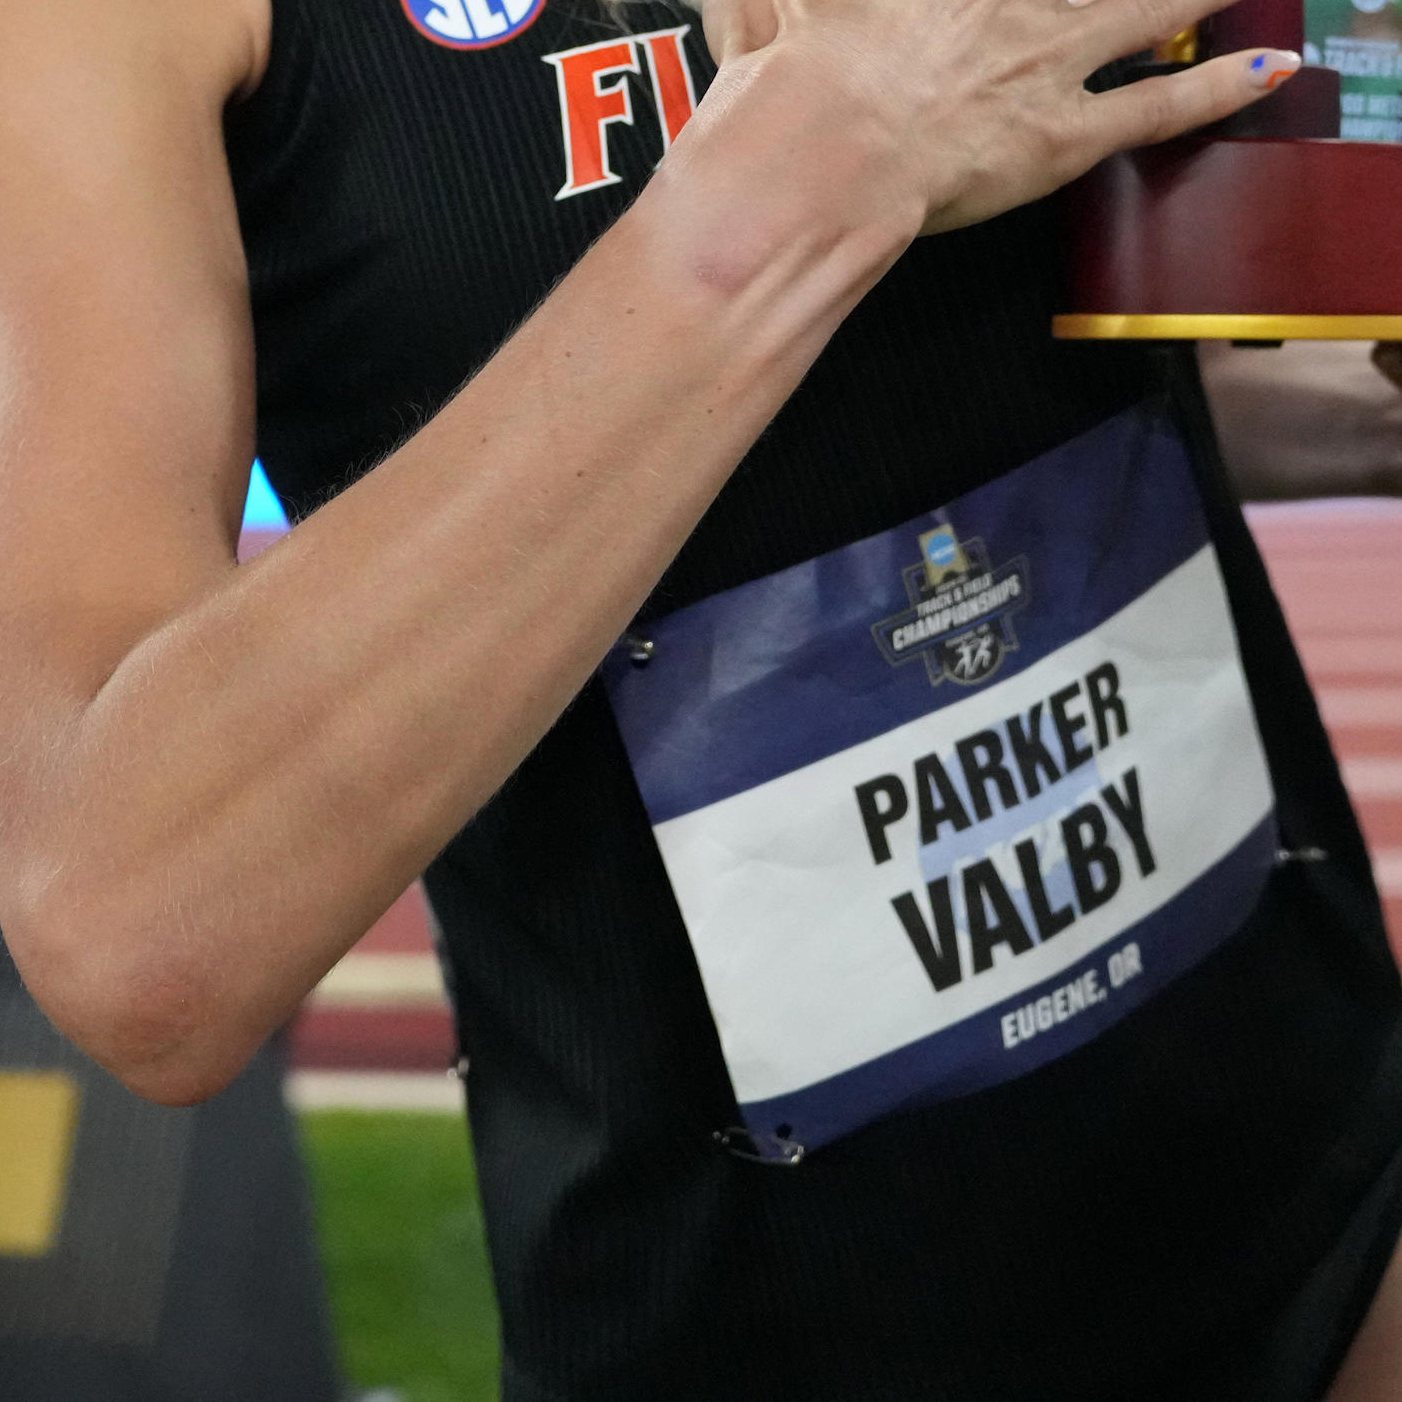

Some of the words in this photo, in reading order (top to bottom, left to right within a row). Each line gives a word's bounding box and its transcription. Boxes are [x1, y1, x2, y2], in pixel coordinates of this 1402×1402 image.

[891, 573, 1021, 651] CHAMPIONSHIPS
[853, 659, 1131, 867] PARKER
[889, 766, 1159, 995] VALBY
[1000, 968, 1108, 1049] EUGENE,
[1107, 942, 1143, 988] OR
